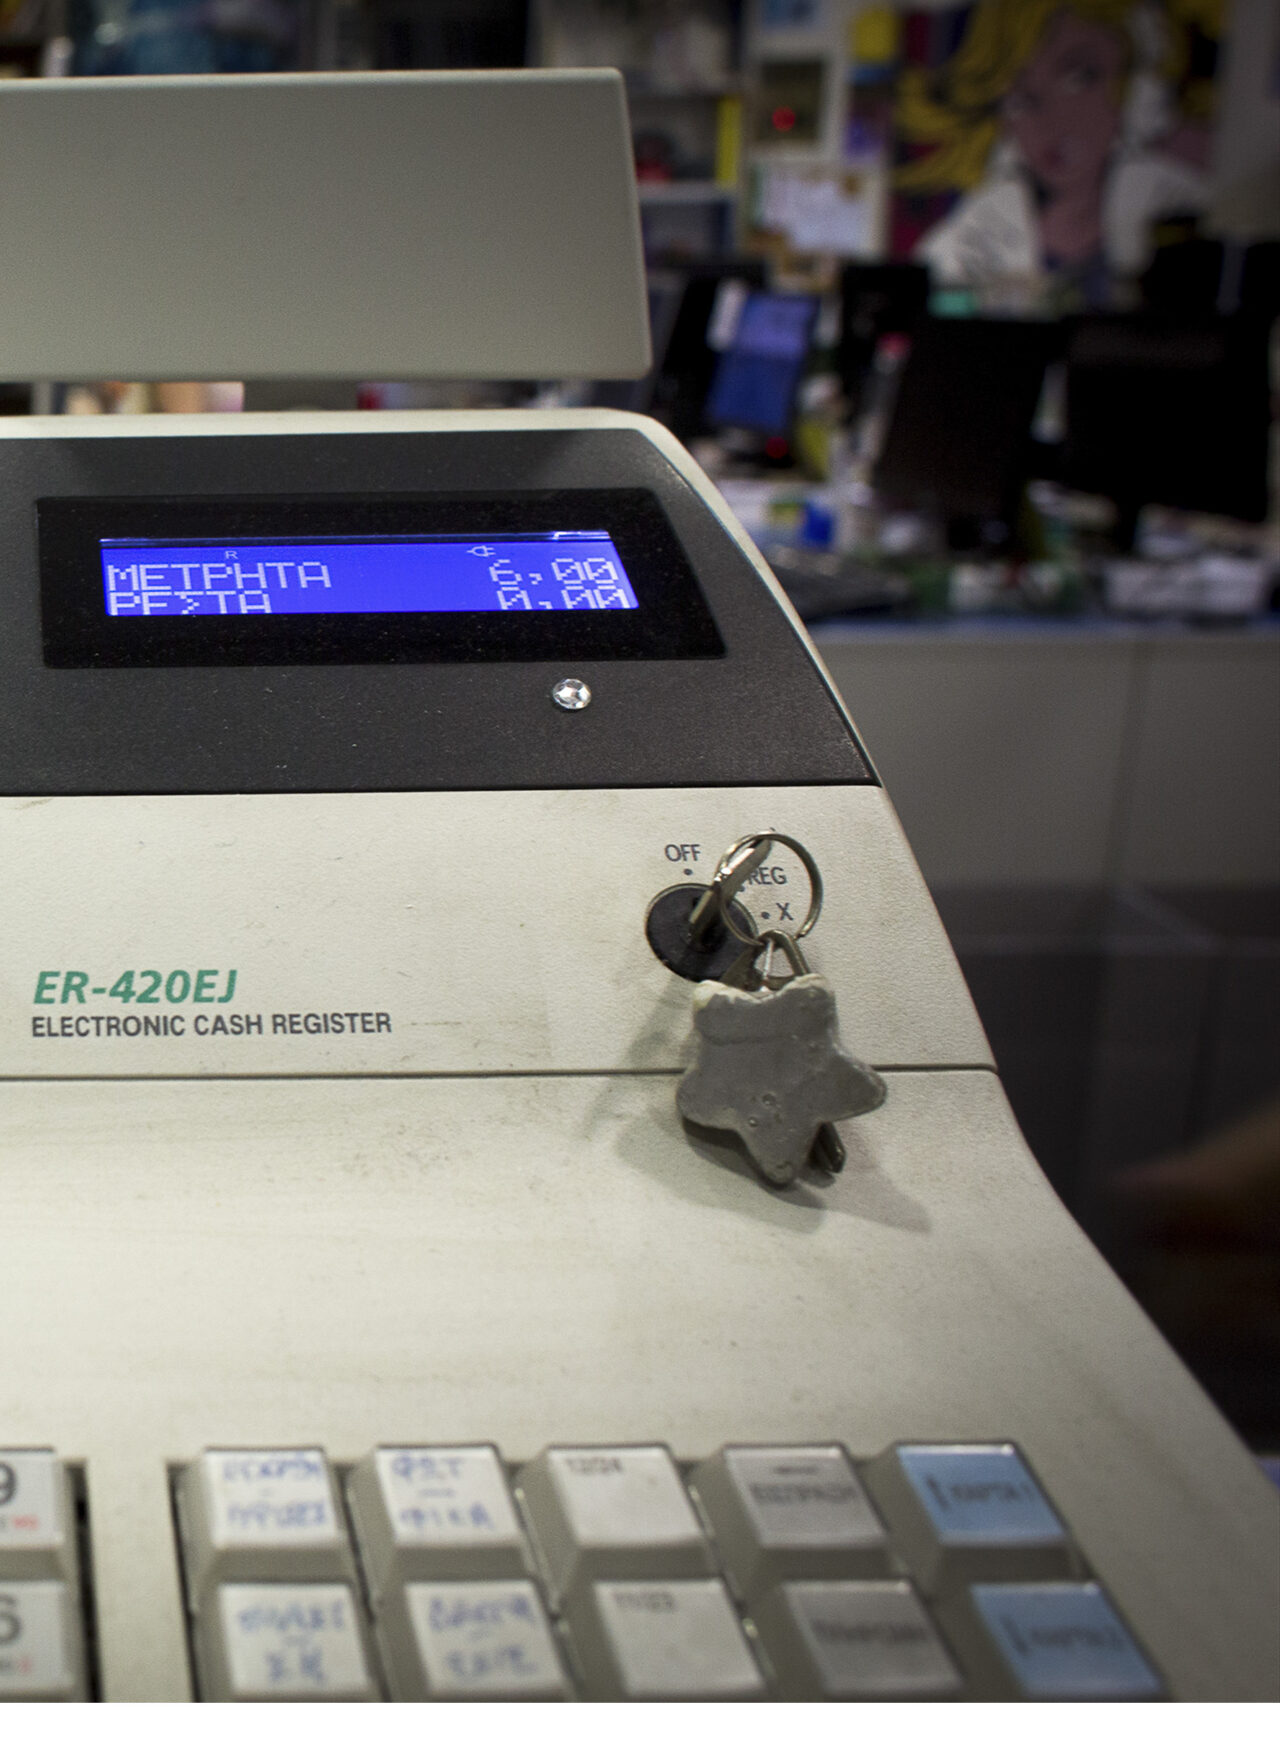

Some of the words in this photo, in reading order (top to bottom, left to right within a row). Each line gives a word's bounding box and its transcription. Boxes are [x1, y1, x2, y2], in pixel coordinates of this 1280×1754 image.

[107, 562, 331, 591] ΜΕΤΡΗΤΑ
[489, 558, 619, 585] 6,00
[664, 844, 701, 862] OFF
[749, 867, 787, 885] REG
[776, 903, 793, 921] X
[33, 969, 237, 1004] ER-420EJ
[32, 1015, 185, 1037] ELECTRONIC
[194, 1014, 263, 1036] CASH
[273, 1013, 392, 1035] REGISTER
